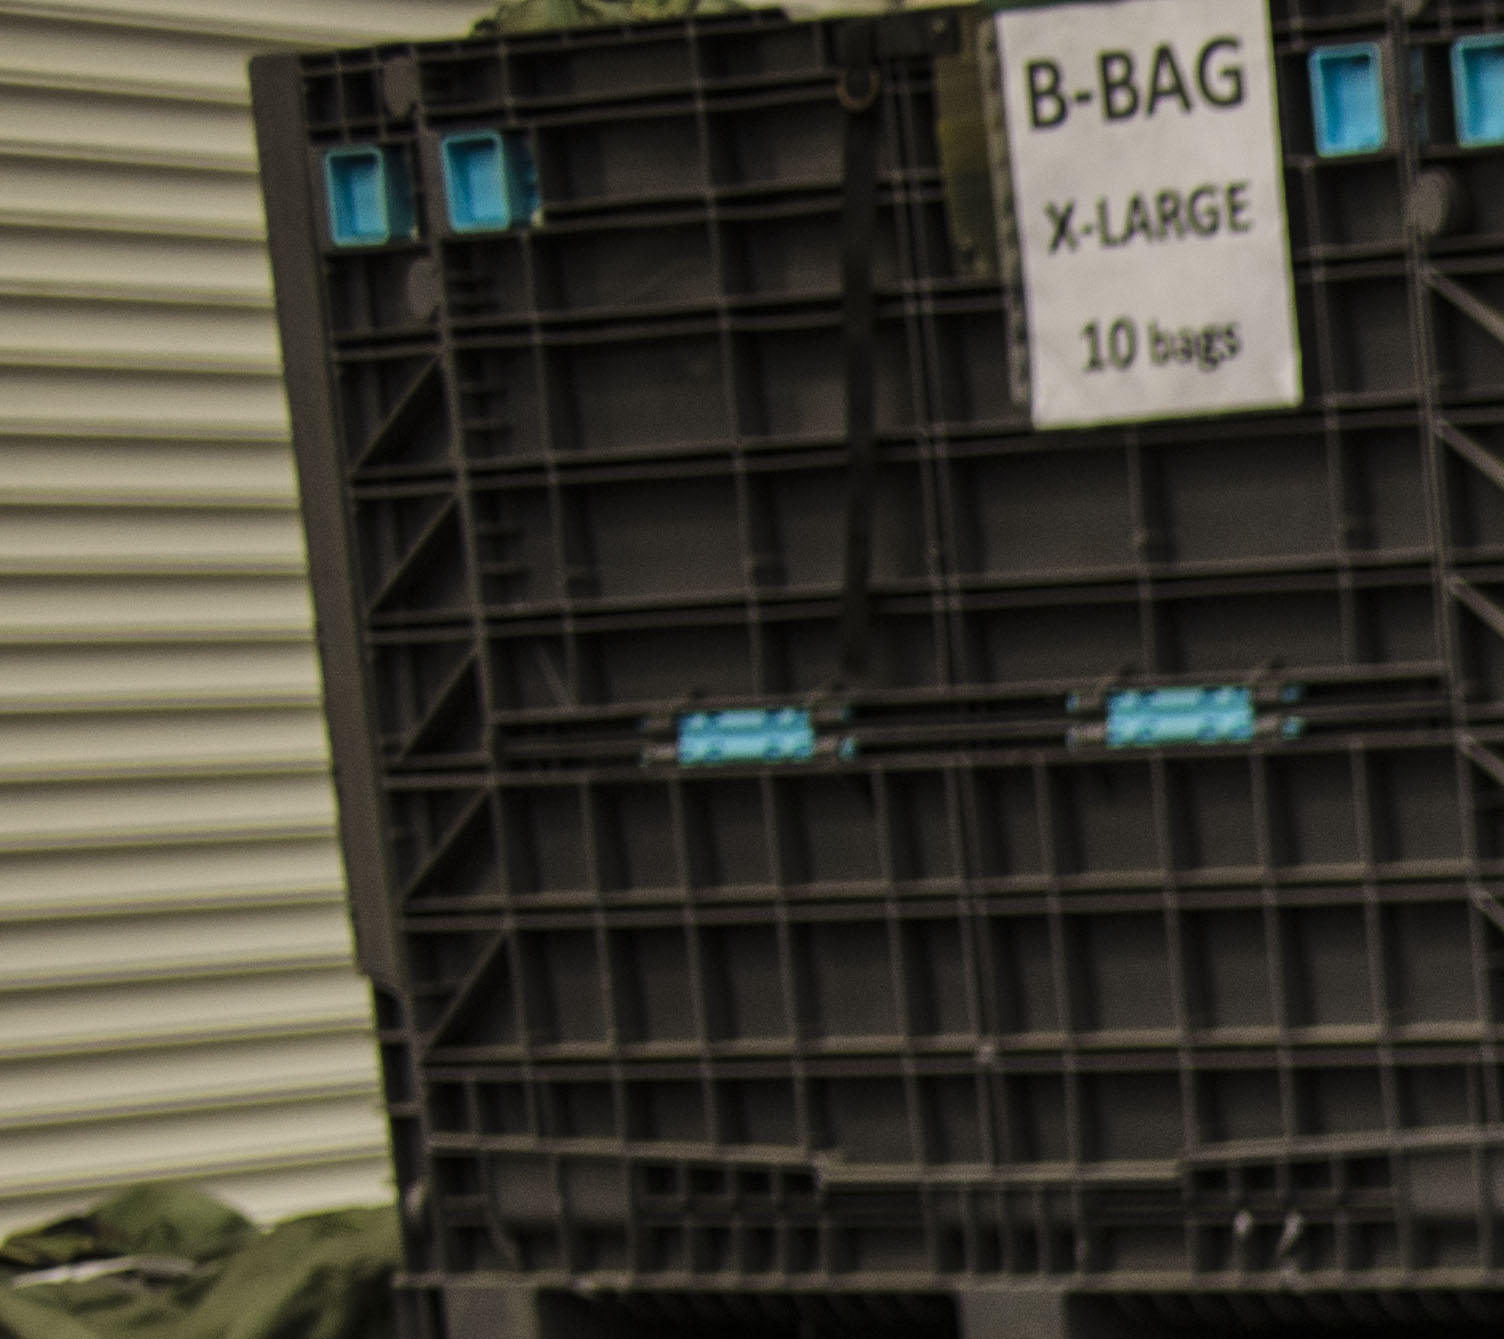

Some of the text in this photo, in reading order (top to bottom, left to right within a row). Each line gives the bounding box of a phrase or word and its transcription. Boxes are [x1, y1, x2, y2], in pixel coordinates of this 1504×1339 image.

[1024, 35, 1247, 132] B-BAG
[1045, 182, 1251, 254] X-LARGE
[1081, 316, 1242, 373] 10 bags
